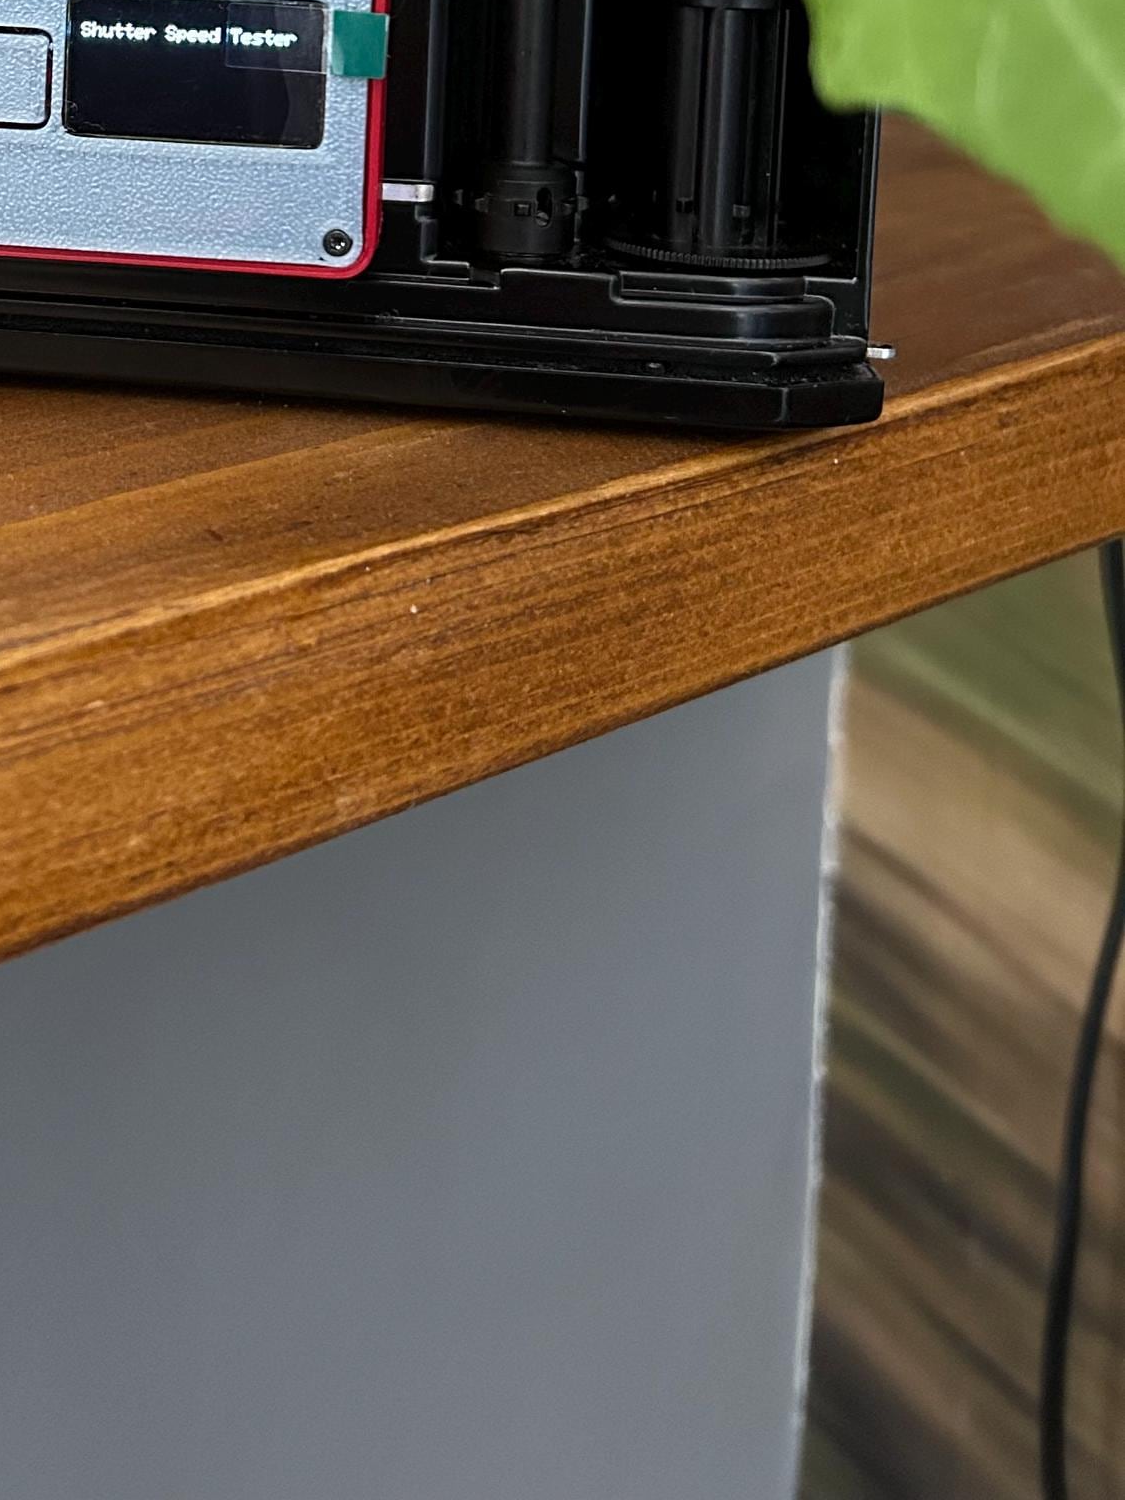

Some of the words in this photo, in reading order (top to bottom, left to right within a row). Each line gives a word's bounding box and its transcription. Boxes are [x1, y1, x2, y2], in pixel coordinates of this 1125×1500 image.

[80, 21, 157, 41] Shutter
[164, 24, 222, 44] Speed
[230, 27, 298, 47] Tester
